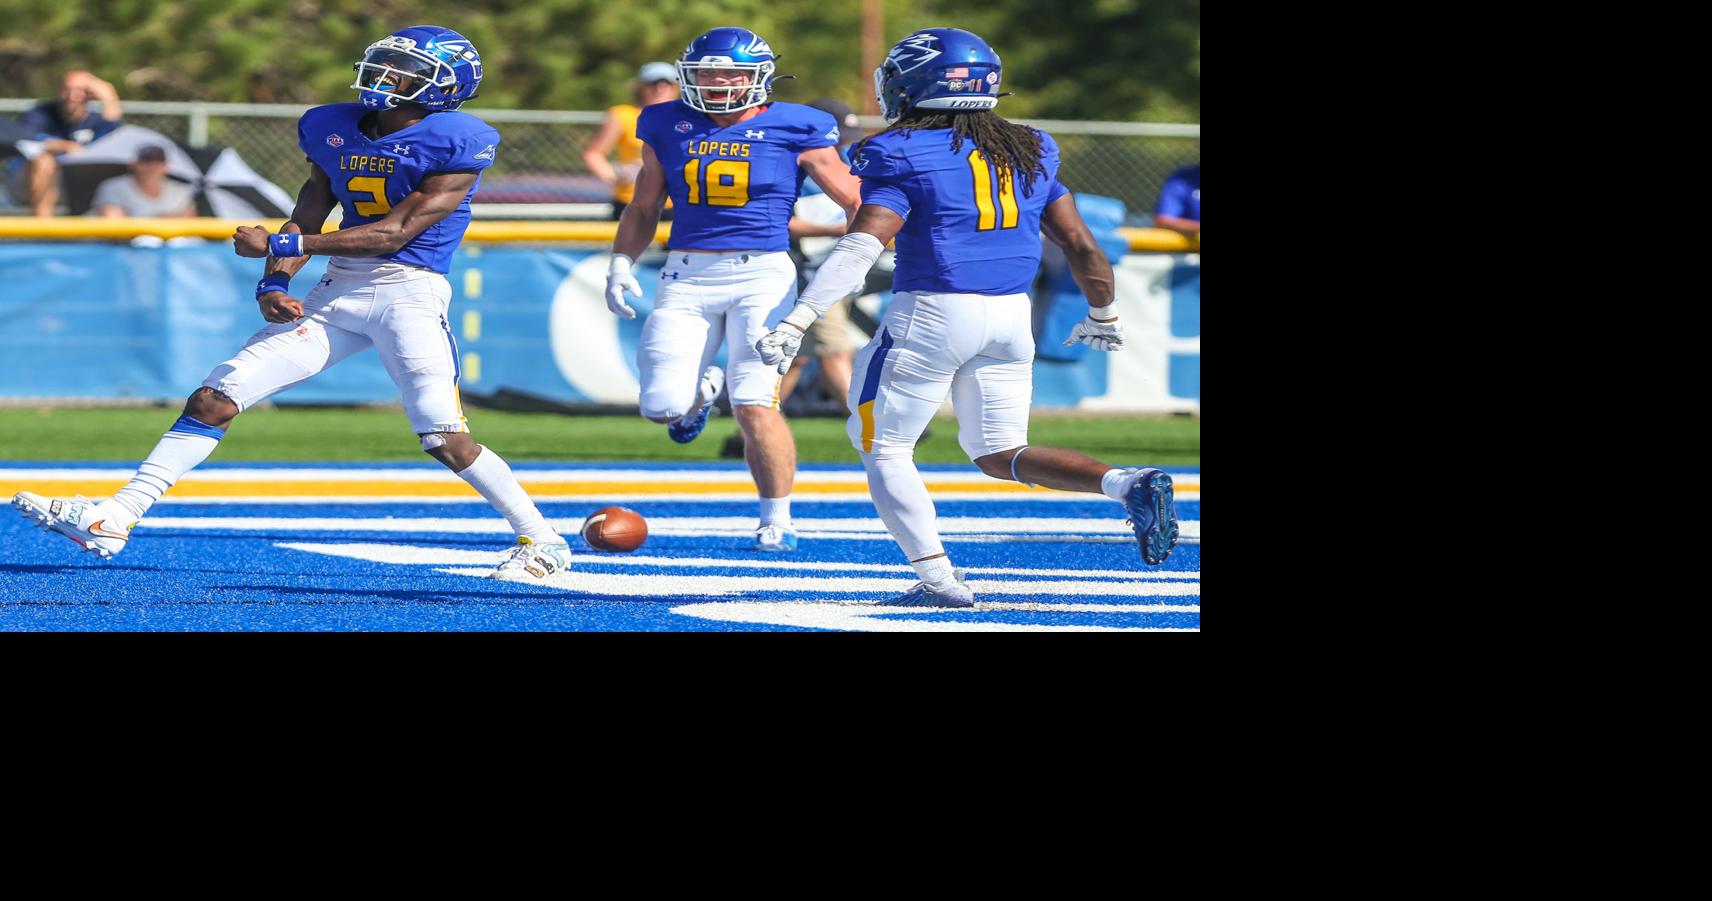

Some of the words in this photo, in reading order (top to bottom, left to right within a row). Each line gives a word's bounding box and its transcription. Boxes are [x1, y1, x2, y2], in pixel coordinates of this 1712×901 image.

[967, 79, 982, 92] 11
[950, 100, 993, 108] LOPERS
[688, 139, 750, 157] LOPERS
[339, 155, 396, 174] LOPERS
[684, 158, 750, 208] 19
[967, 149, 1019, 232] 11
